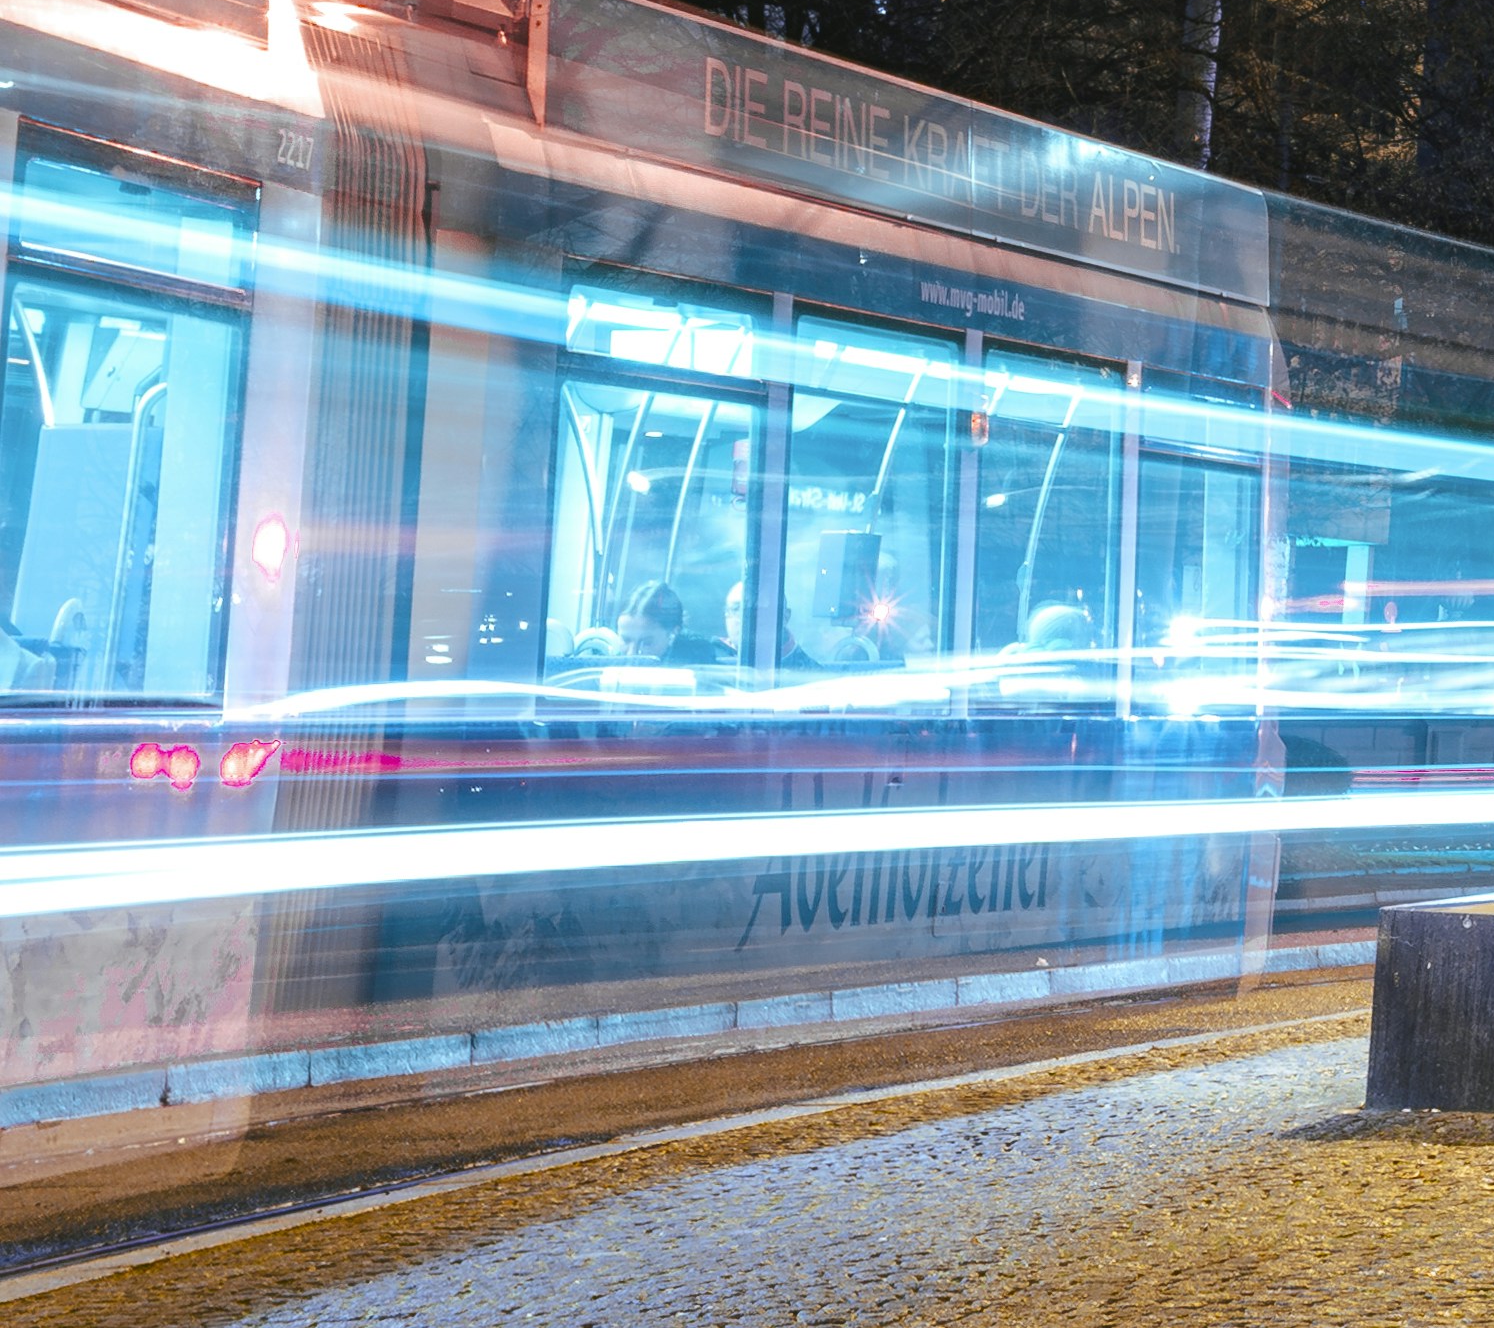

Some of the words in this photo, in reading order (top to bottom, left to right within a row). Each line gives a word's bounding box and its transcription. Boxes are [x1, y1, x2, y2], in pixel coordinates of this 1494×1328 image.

[278, 128, 314, 171] 2217
[705, 57, 768, 149] DIE
[783, 80, 891, 180] REINE
[903, 115, 1010, 211] KRAFT
[1021, 149, 1079, 230] DER
[1088, 171, 1180, 254] ALPEN.
[921, 281, 1025, 320] www.mvg-mobil.de
